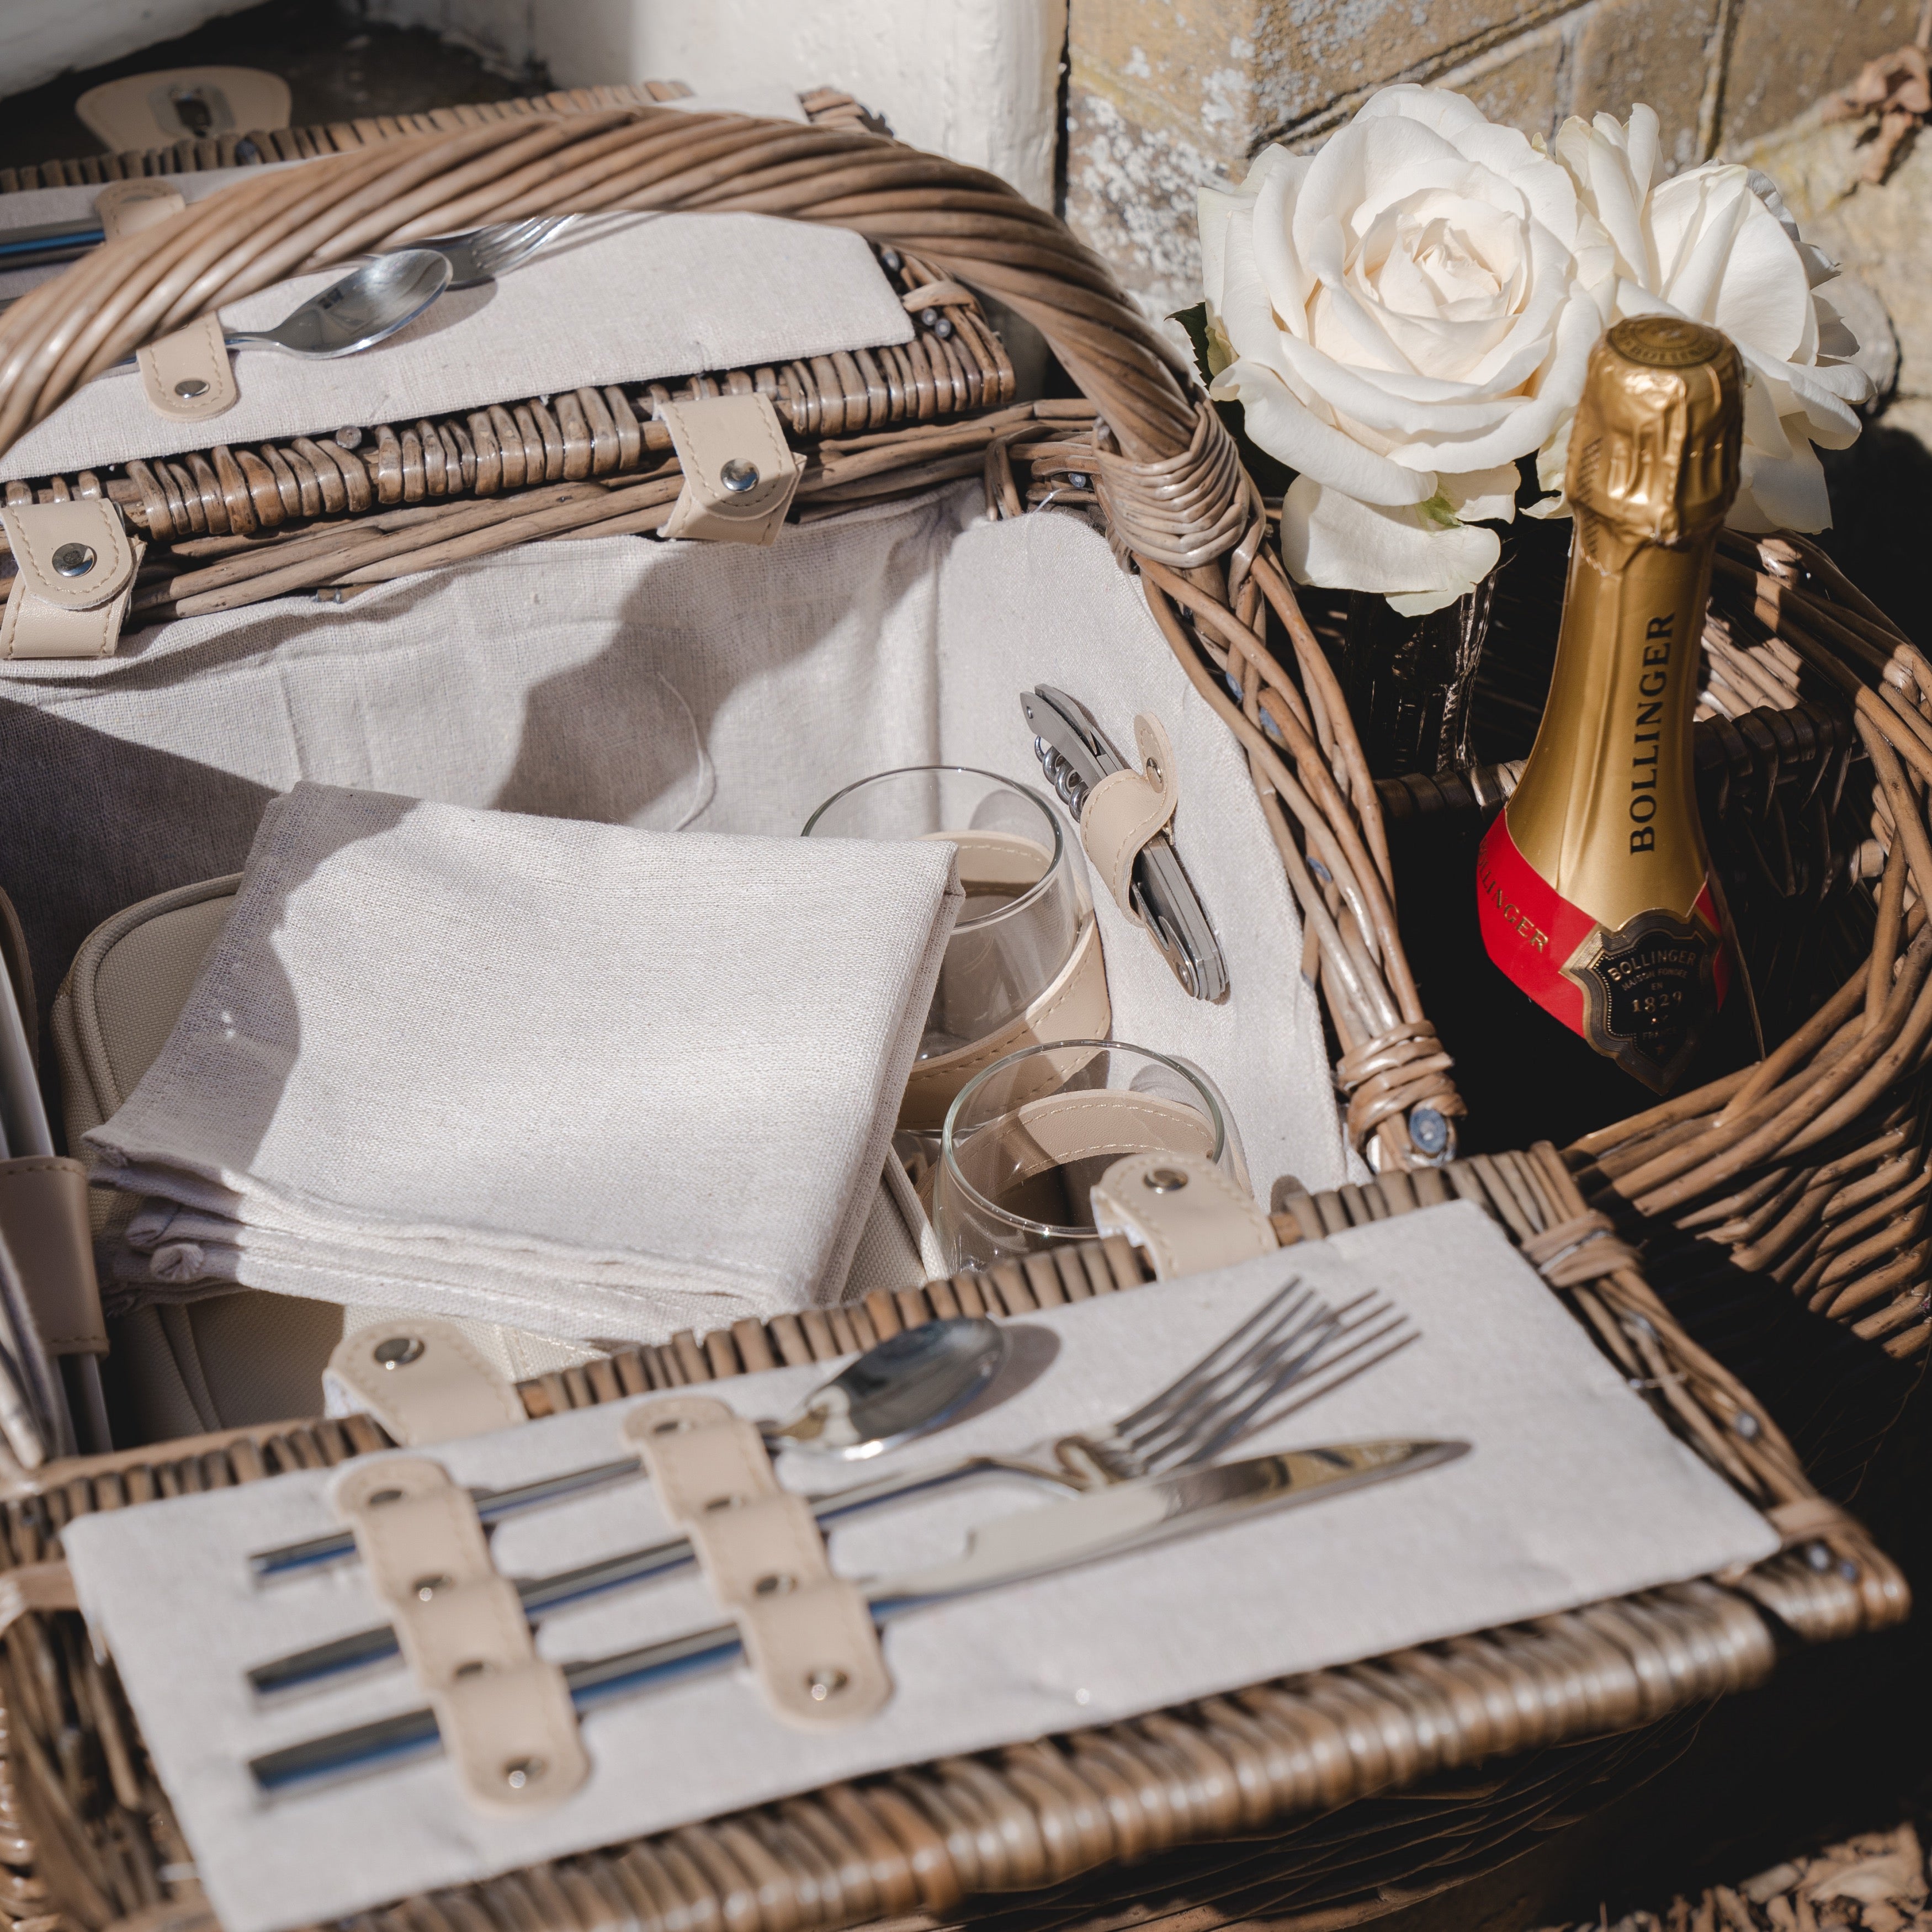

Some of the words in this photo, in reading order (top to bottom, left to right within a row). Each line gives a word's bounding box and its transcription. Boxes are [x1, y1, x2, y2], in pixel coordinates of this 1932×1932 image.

[1630, 612, 1675, 855] BOLLINGER
[1607, 949, 1696, 981] BOLLINGER
[1621, 970, 1655, 991] MAISON
[1651, 982, 1663, 990] EN
[1632, 990, 1682, 1013] 1829
